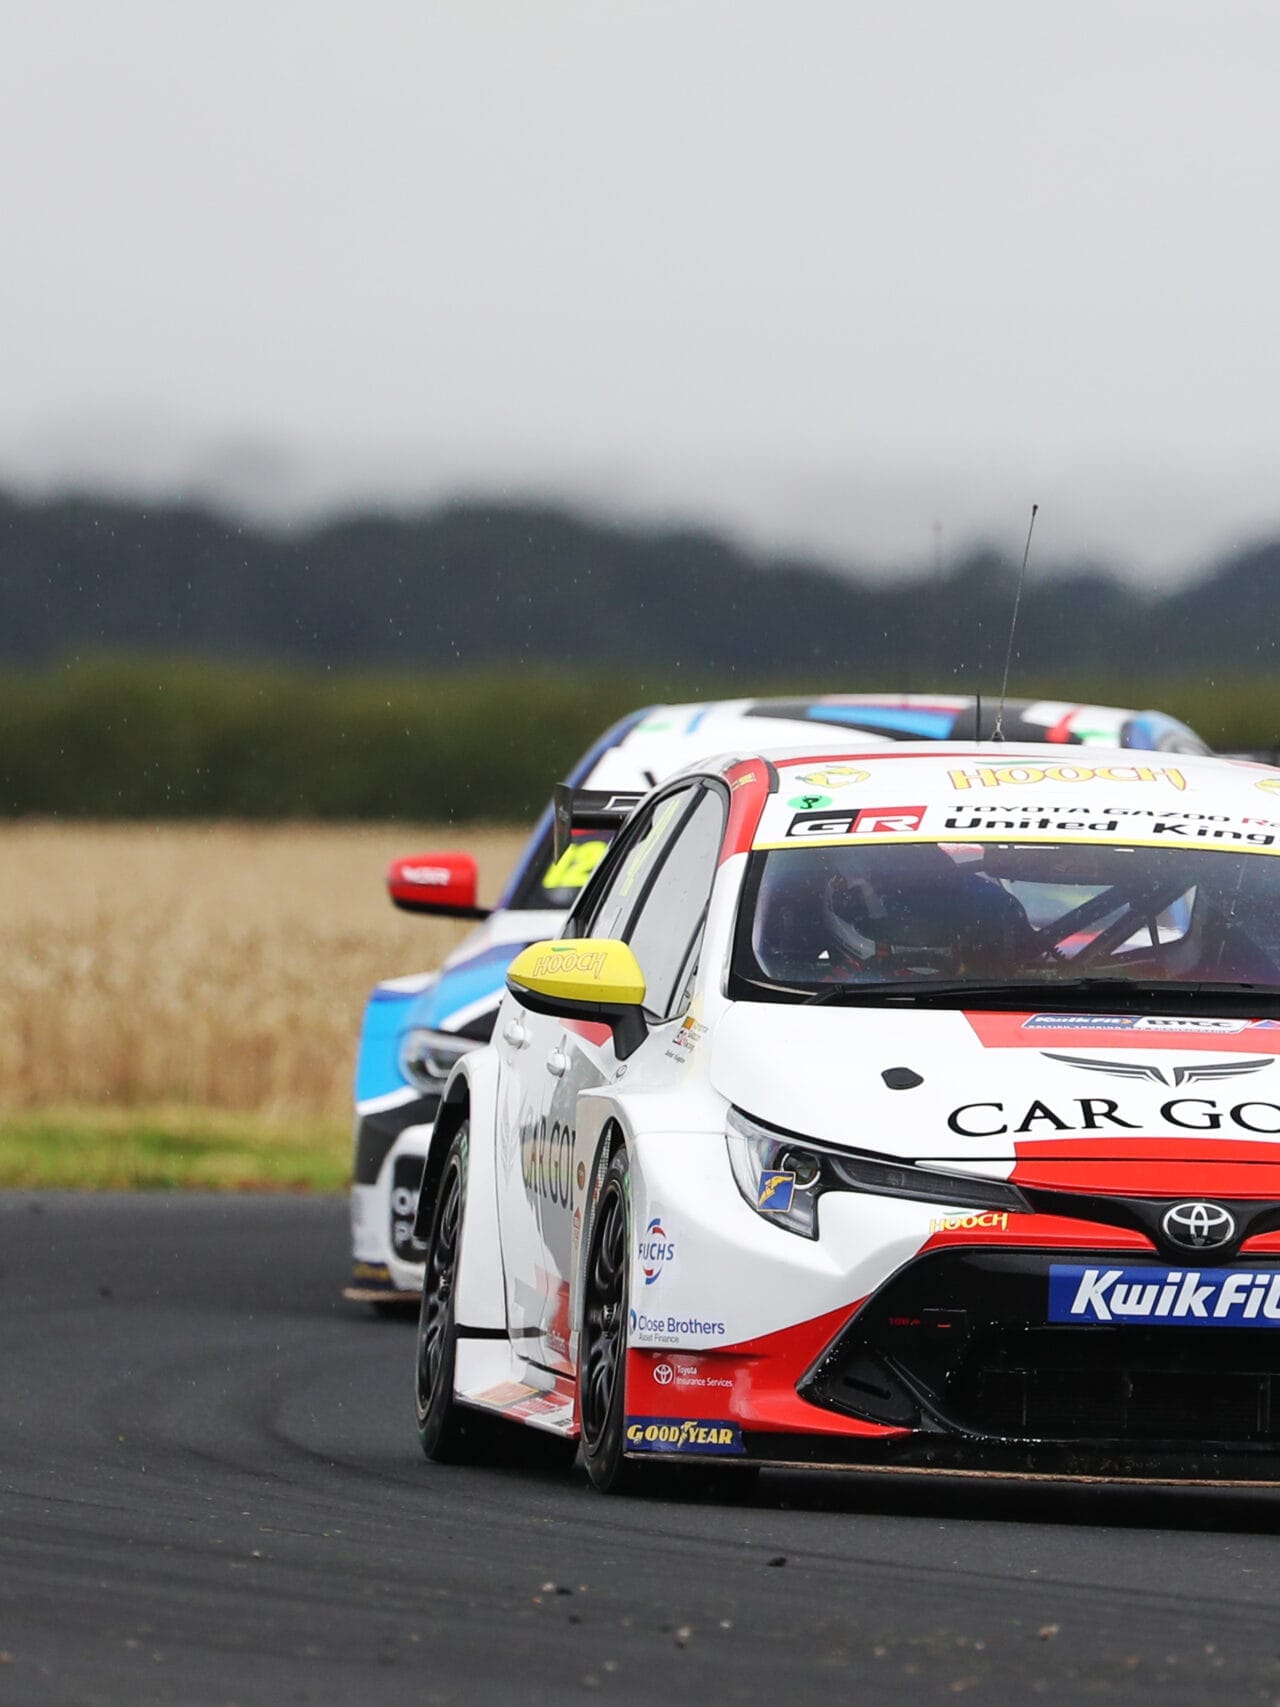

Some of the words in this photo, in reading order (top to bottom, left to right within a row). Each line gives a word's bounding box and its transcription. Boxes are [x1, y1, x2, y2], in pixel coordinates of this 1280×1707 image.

[947, 766, 1187, 790] HOOCH
[949, 805, 1091, 814] TOYOTA
[1103, 807, 1231, 822] GAZOO
[945, 818, 1119, 832] United
[533, 952, 608, 979] HOOCH
[947, 1098, 1143, 1137] CAR
[930, 1213, 1009, 1234] HOOCH
[638, 1243, 674, 1261] FUCHS
[638, 1315, 665, 1332] Close
[667, 1317, 726, 1335] Brothers
[676, 1365, 698, 1376] Toyota
[676, 1376, 705, 1386] Insurance
[707, 1377, 733, 1387] Services
[627, 1422, 734, 1447] GOODYEAR
